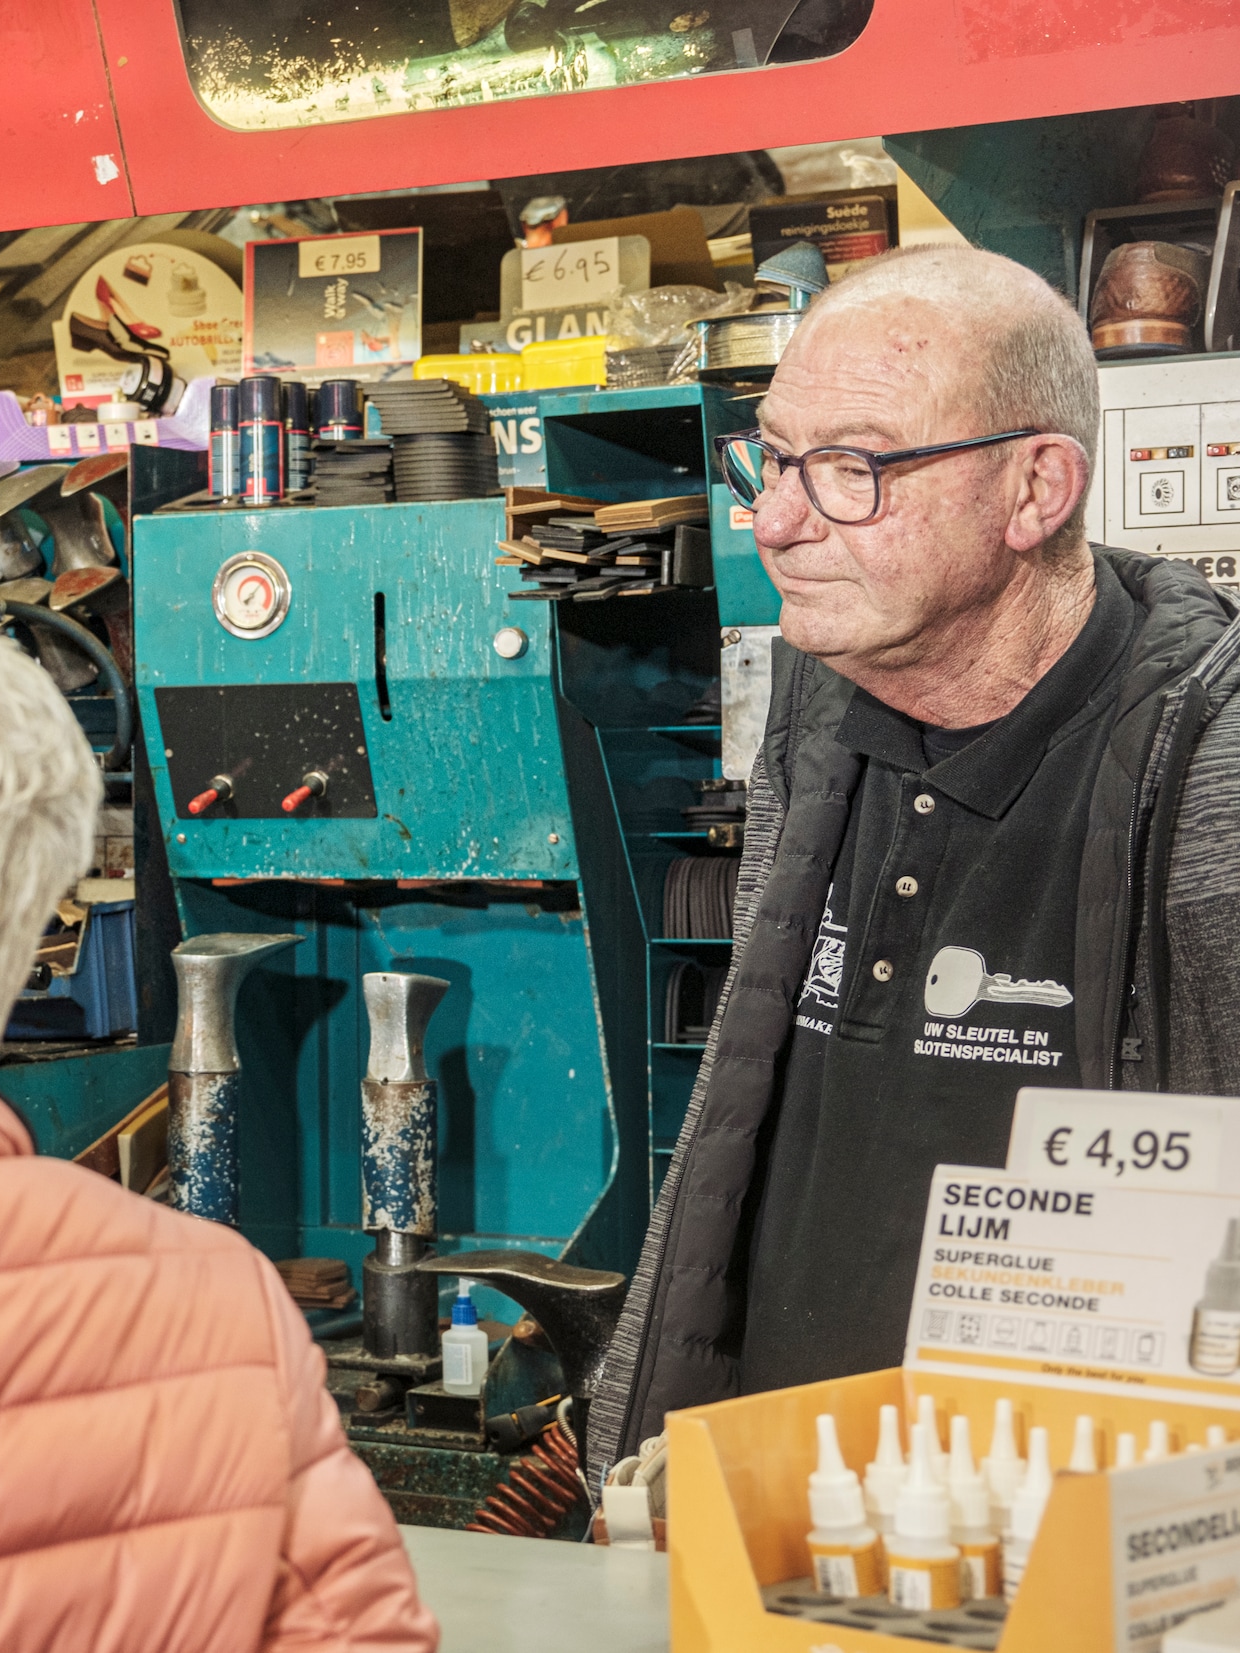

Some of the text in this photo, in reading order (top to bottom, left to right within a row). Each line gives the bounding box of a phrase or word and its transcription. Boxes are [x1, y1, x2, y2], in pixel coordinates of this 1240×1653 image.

[826, 203, 869, 219] Suède
[553, 249, 610, 283] 6.95
[1188, 556, 1237, 578] ER
[924, 1022, 1049, 1046] UW SLEUTEL EN
[914, 1039, 1062, 1067] SLOTENSPECIALIST
[1044, 1126, 1192, 1178] € 4,95
[943, 1183, 1095, 1216] SECONDE
[938, 1214, 1011, 1241] LIJM
[934, 1249, 1055, 1272] SUPERGLUE
[930, 1264, 1126, 1296] SEKUNDENKLEBER
[928, 1282, 1100, 1312] COLLE SECONDE
[1127, 1508, 1240, 1563] SECONDELI
